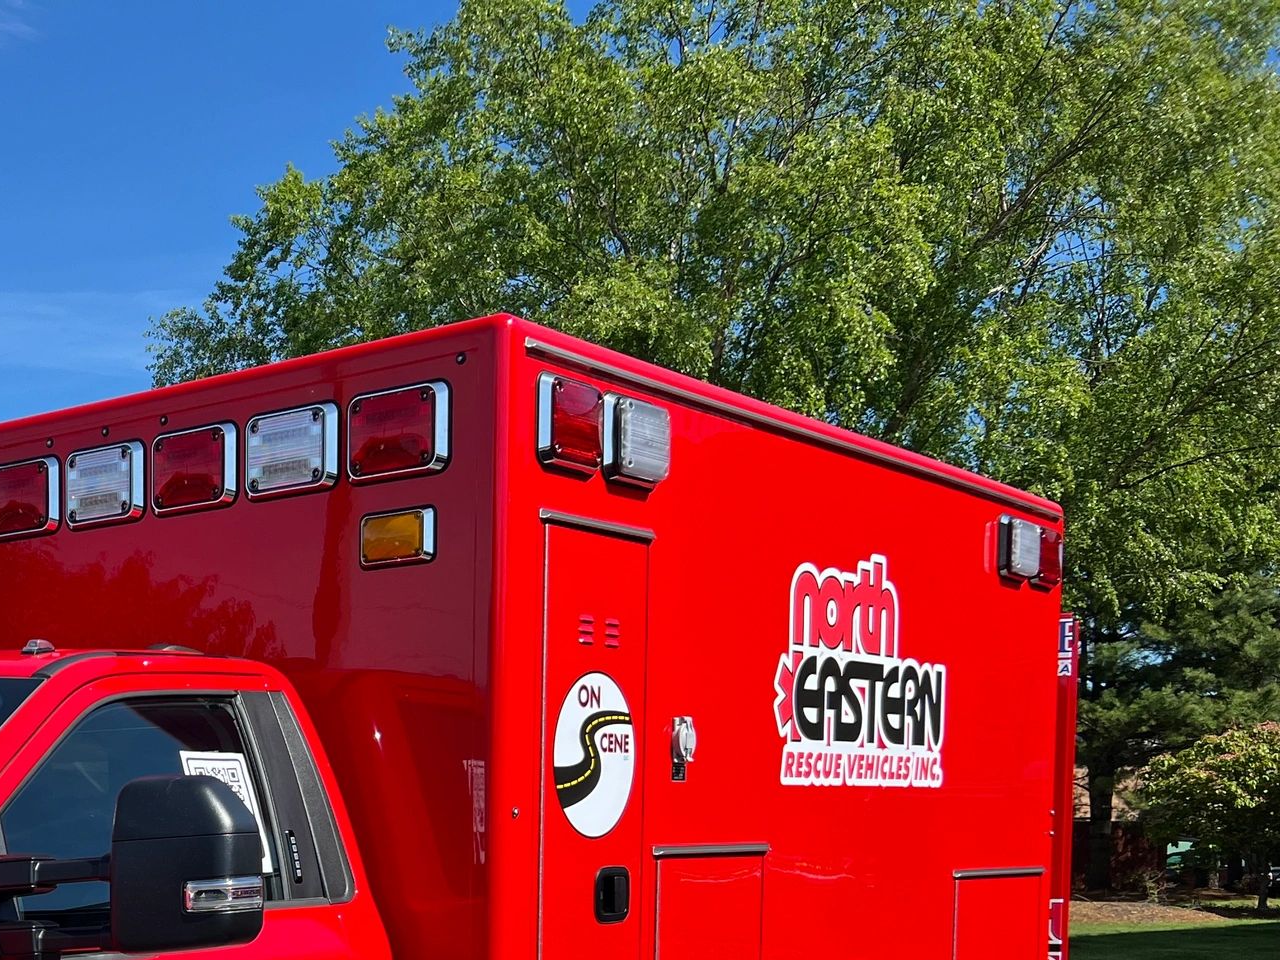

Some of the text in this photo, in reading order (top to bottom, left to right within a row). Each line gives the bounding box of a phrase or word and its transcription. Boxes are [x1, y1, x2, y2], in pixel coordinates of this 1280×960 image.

[793, 562, 895, 658] north
[577, 684, 601, 708] ON
[795, 655, 943, 747] EASTERN
[783, 751, 941, 781] RESCUE VEHICLES INC.
